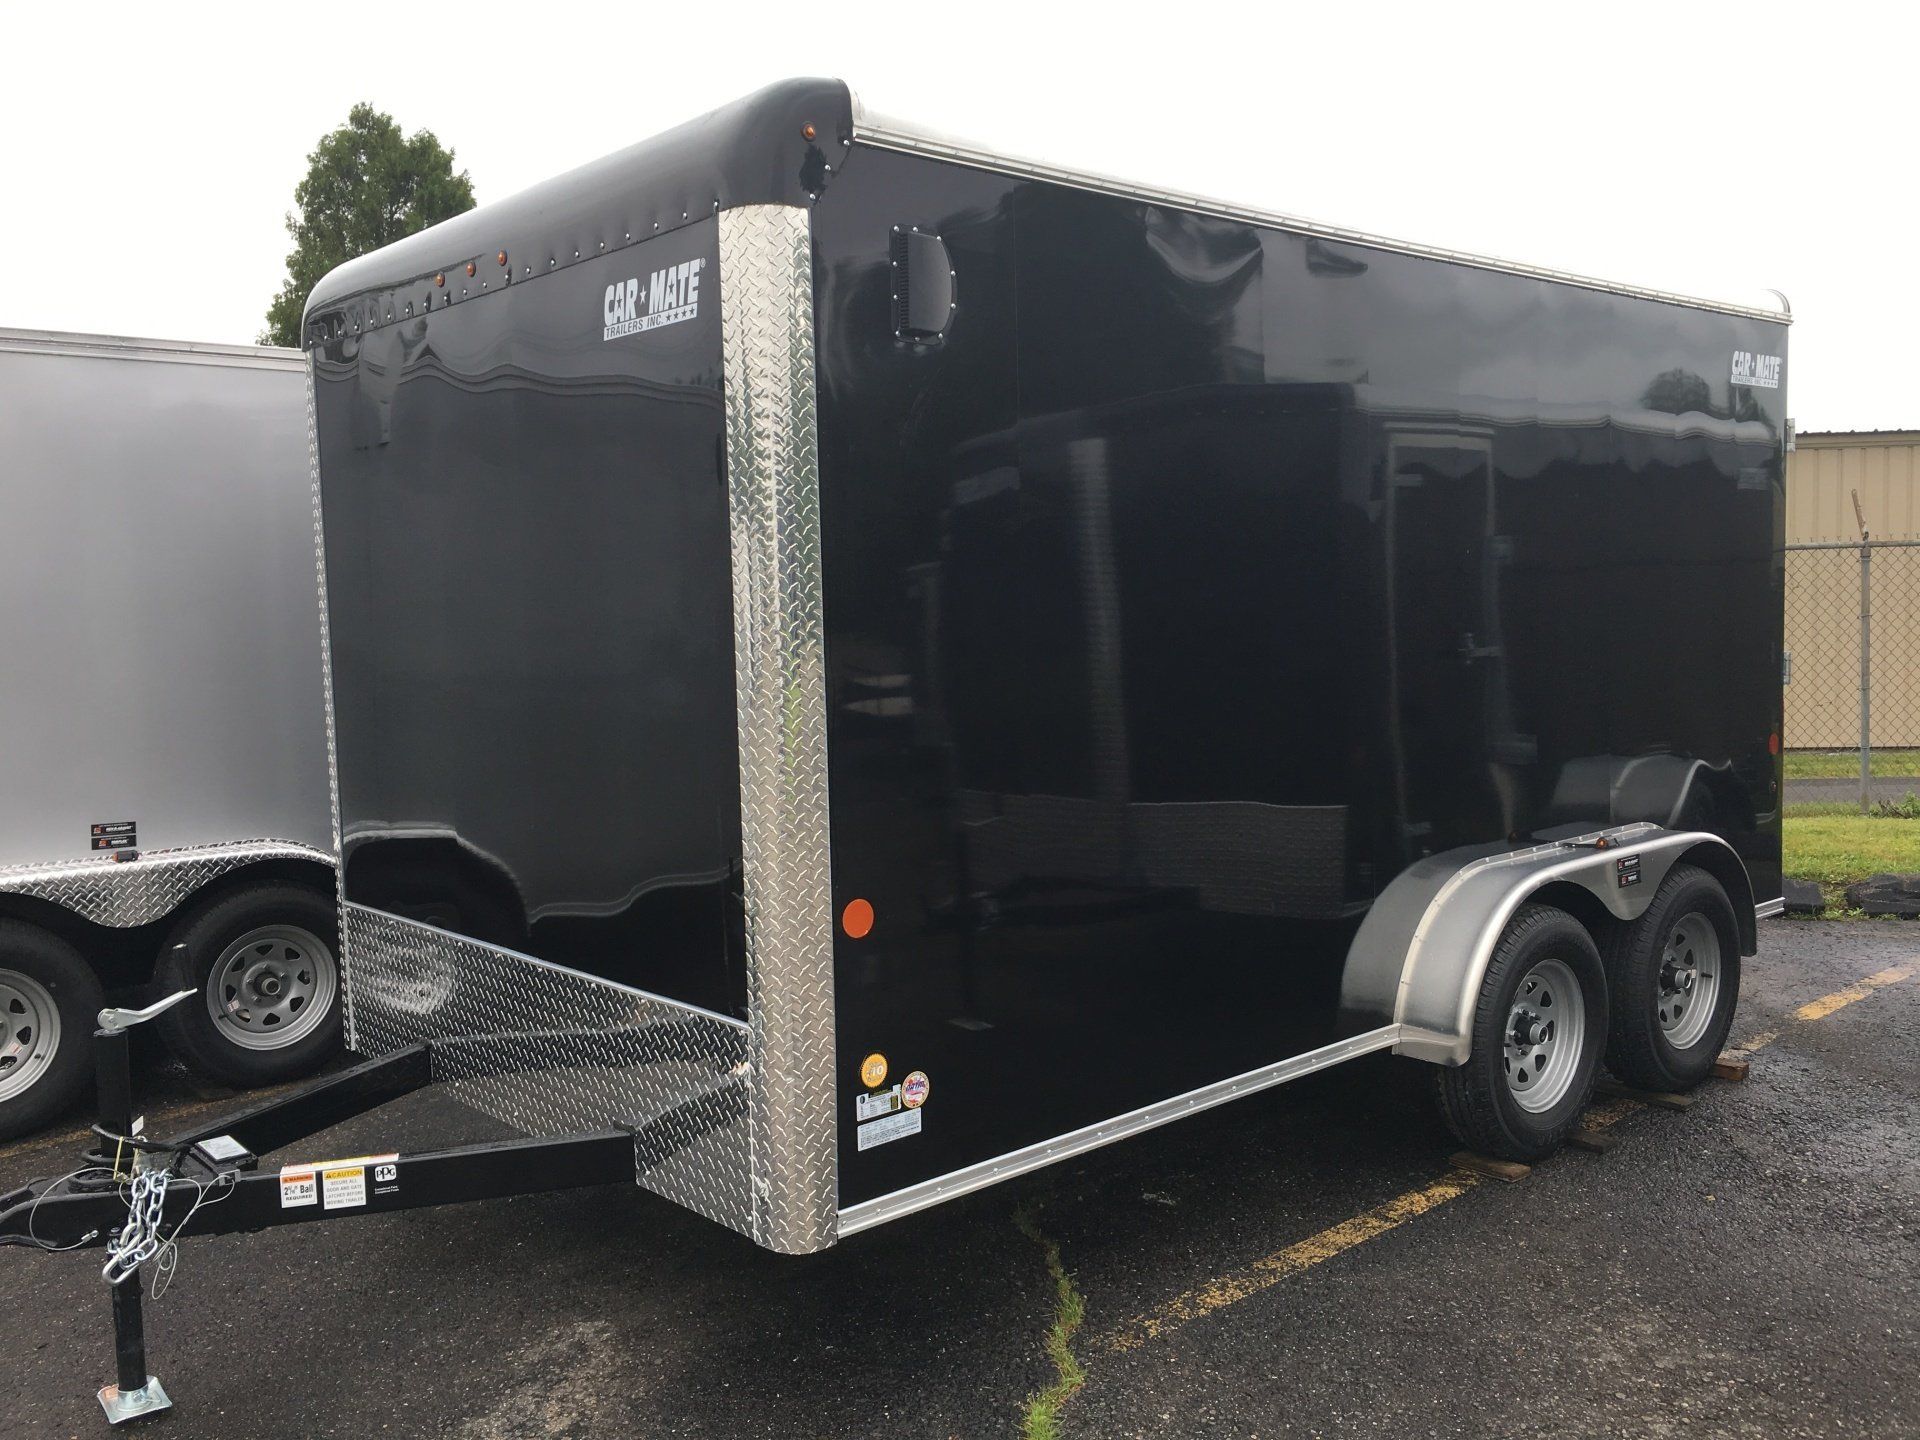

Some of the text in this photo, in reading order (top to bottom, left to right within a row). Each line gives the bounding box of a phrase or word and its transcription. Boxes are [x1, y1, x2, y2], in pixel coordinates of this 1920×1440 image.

[604, 258, 700, 327] CAR MATE
[606, 314, 663, 339] TRAILERS INC.
[1732, 350, 1780, 380] CAR MATE
[332, 1170, 362, 1179] CAUTION
[376, 1167, 395, 1180] PPG
[300, 1183, 314, 1194] Ball
